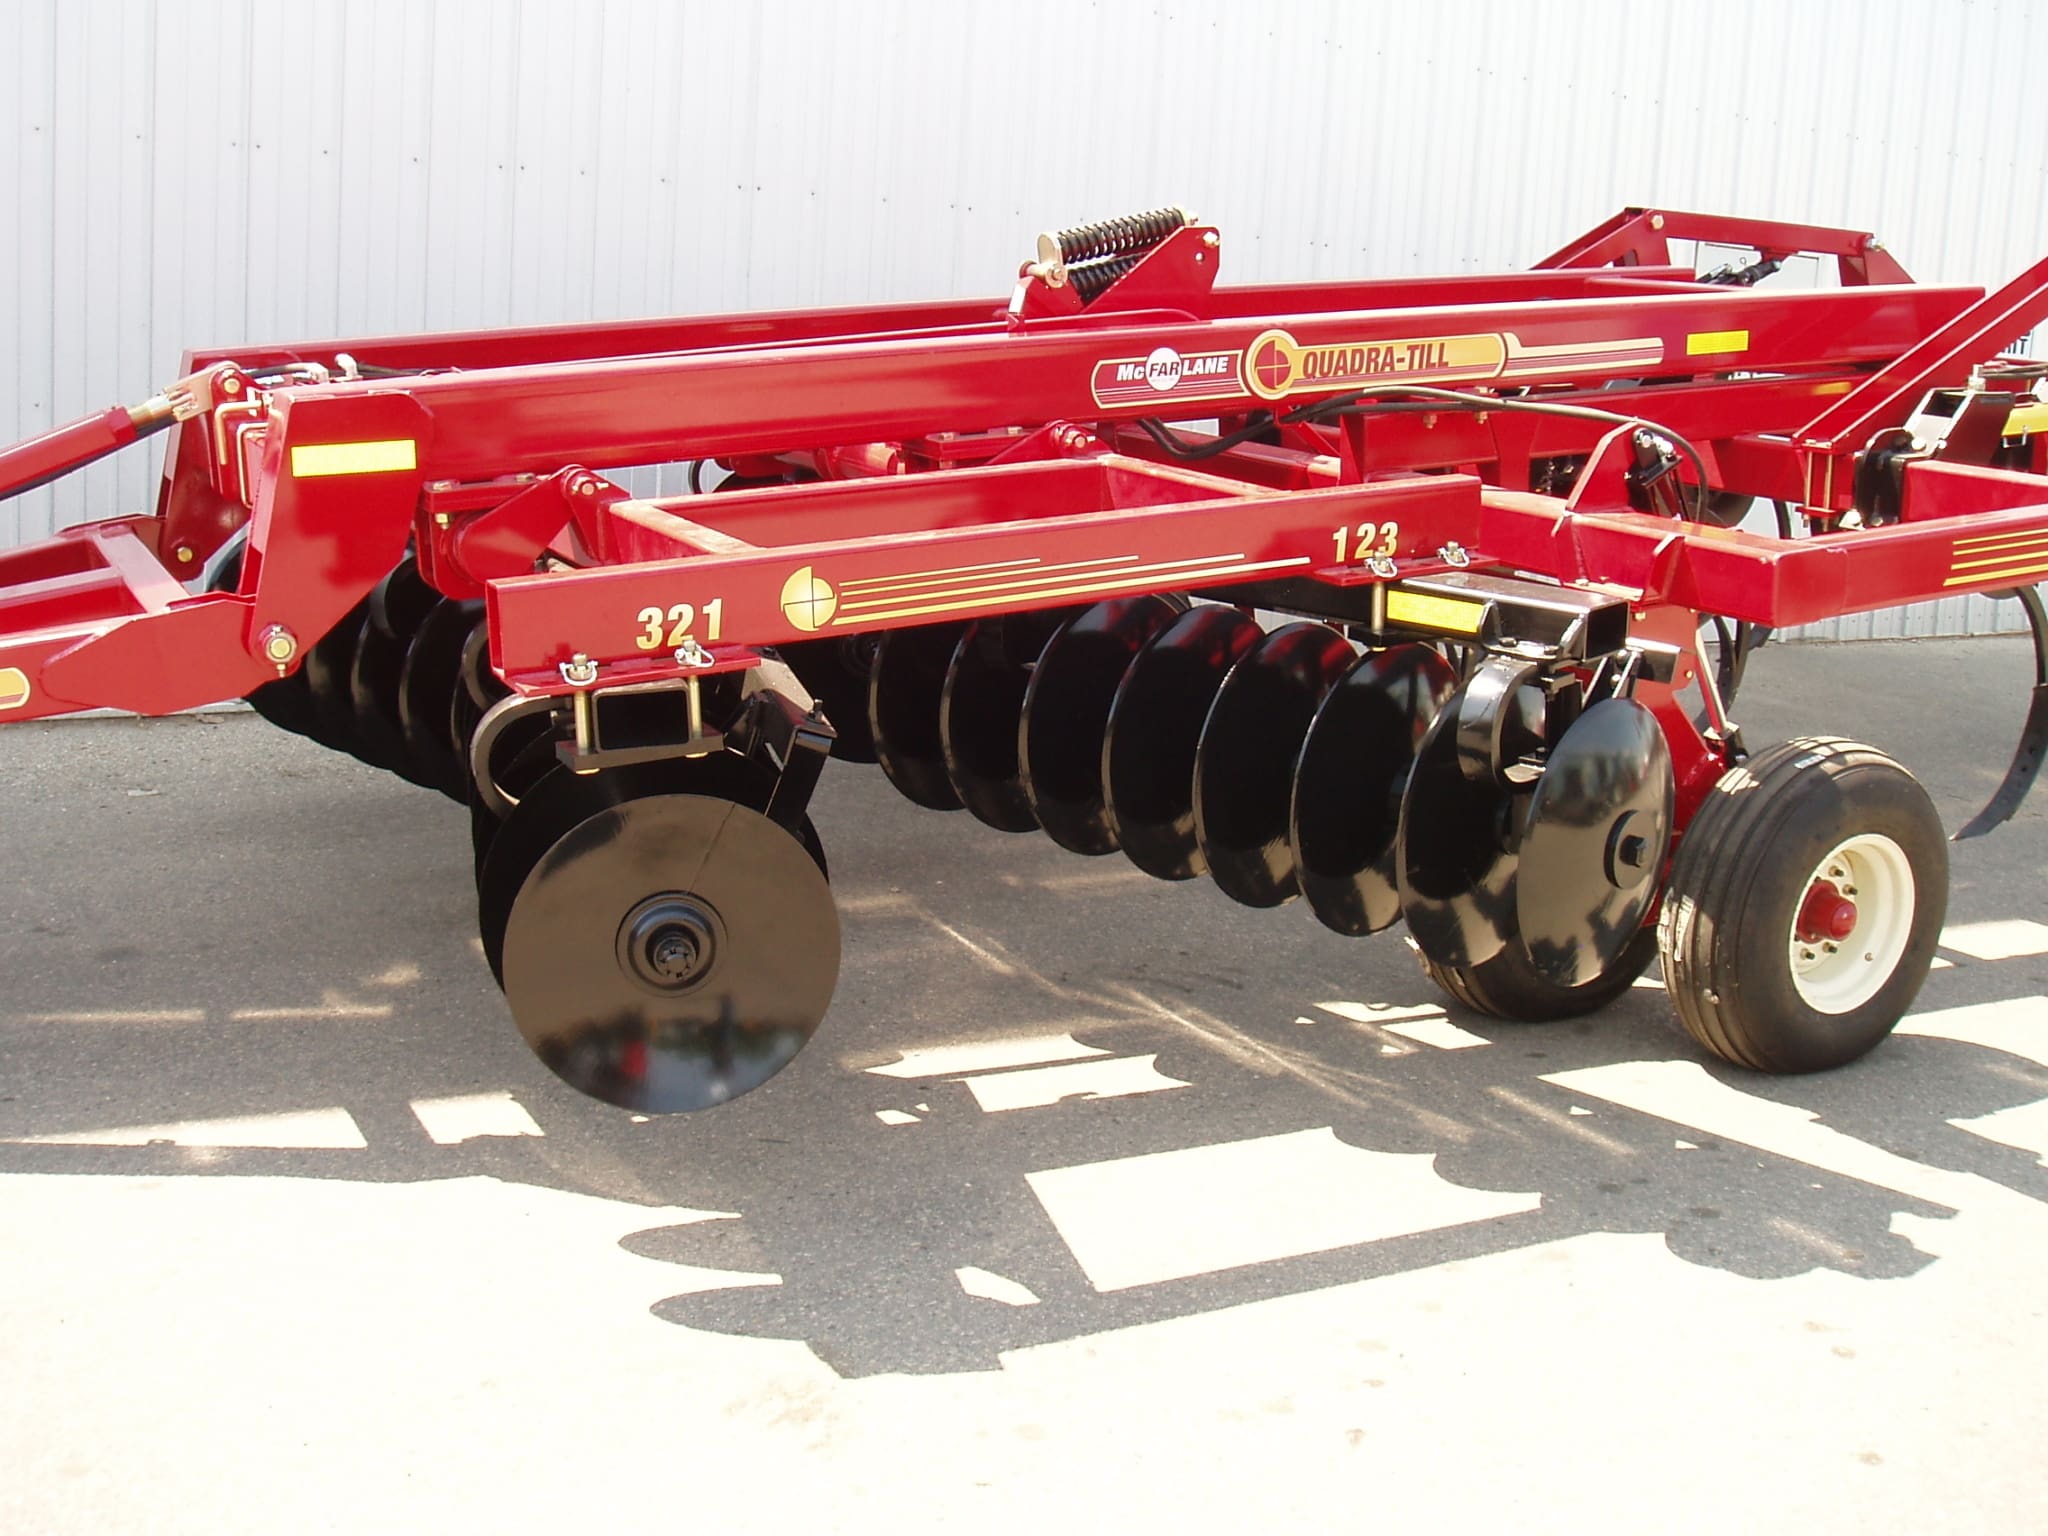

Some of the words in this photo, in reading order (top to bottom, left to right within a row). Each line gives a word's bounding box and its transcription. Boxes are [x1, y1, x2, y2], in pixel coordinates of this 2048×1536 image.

[1303, 343, 1449, 380] QUADRA-TILL
[1332, 521, 1399, 563] 123
[636, 598, 723, 650] 321
